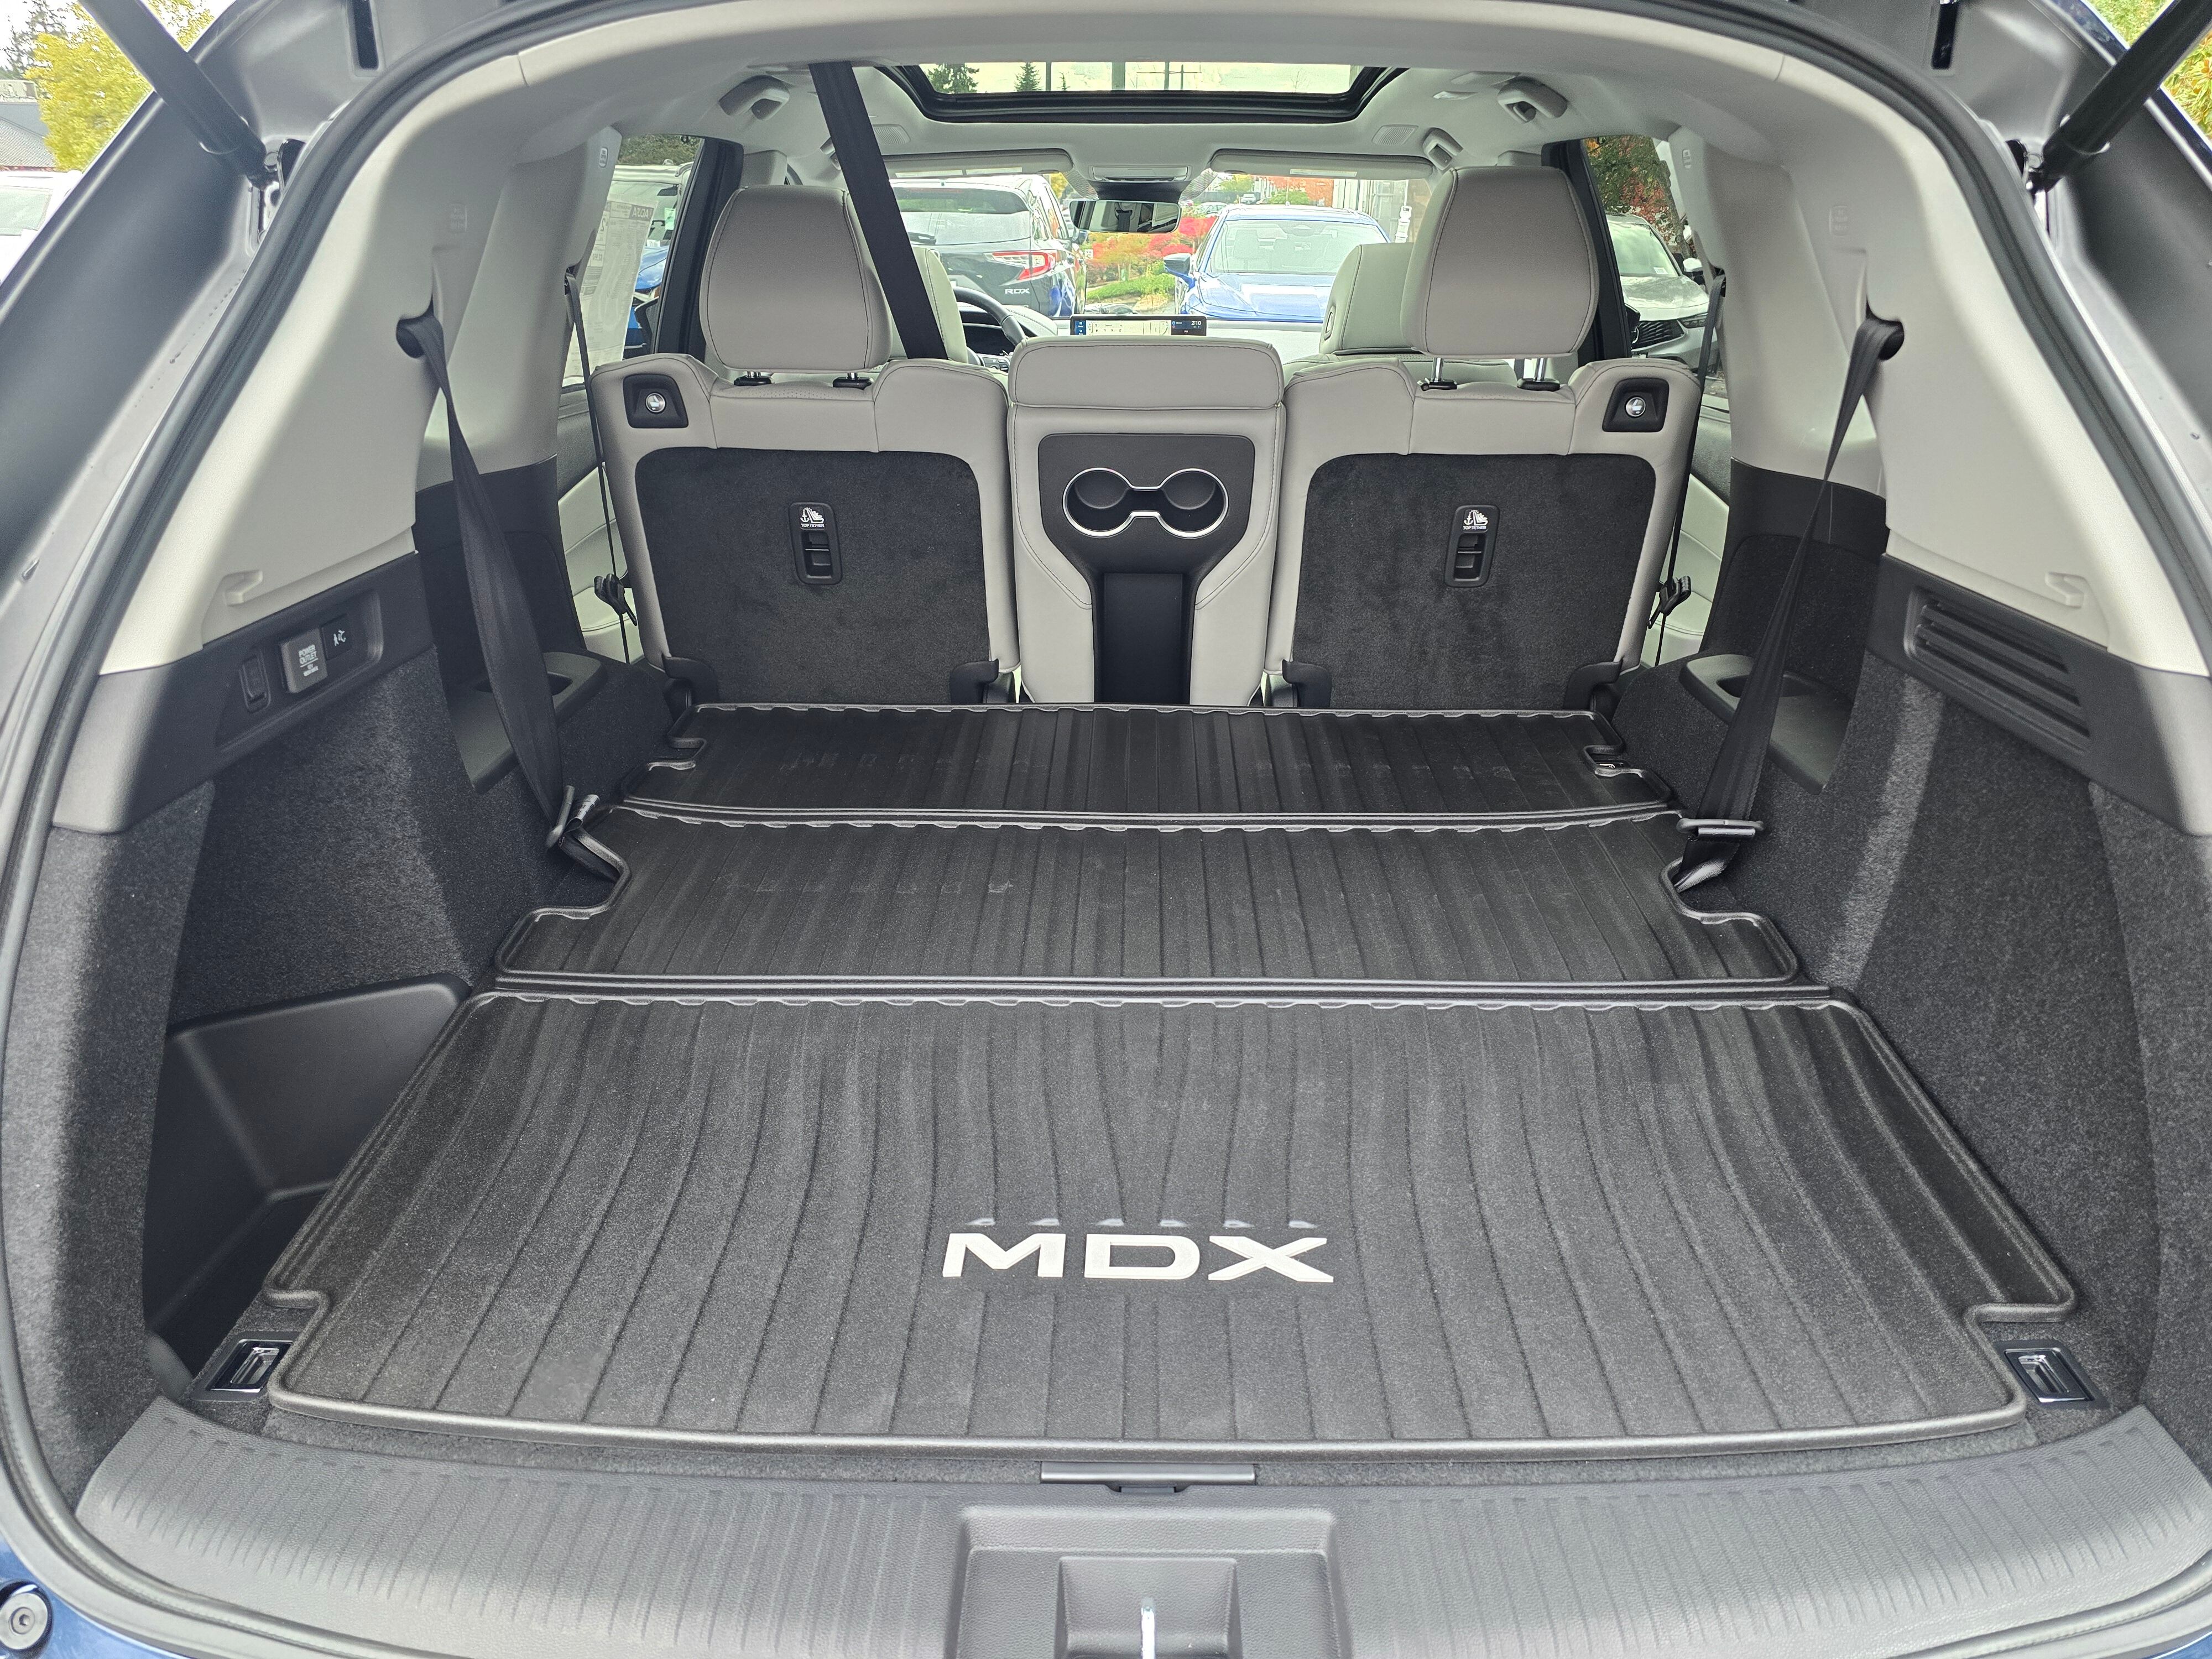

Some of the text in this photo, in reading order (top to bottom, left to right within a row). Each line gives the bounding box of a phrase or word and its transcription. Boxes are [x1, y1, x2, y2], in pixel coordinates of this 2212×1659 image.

[299, 644, 316, 658] POWER
[299, 651, 317, 664] OUTLET
[942, 1233, 1333, 1282] MDX
